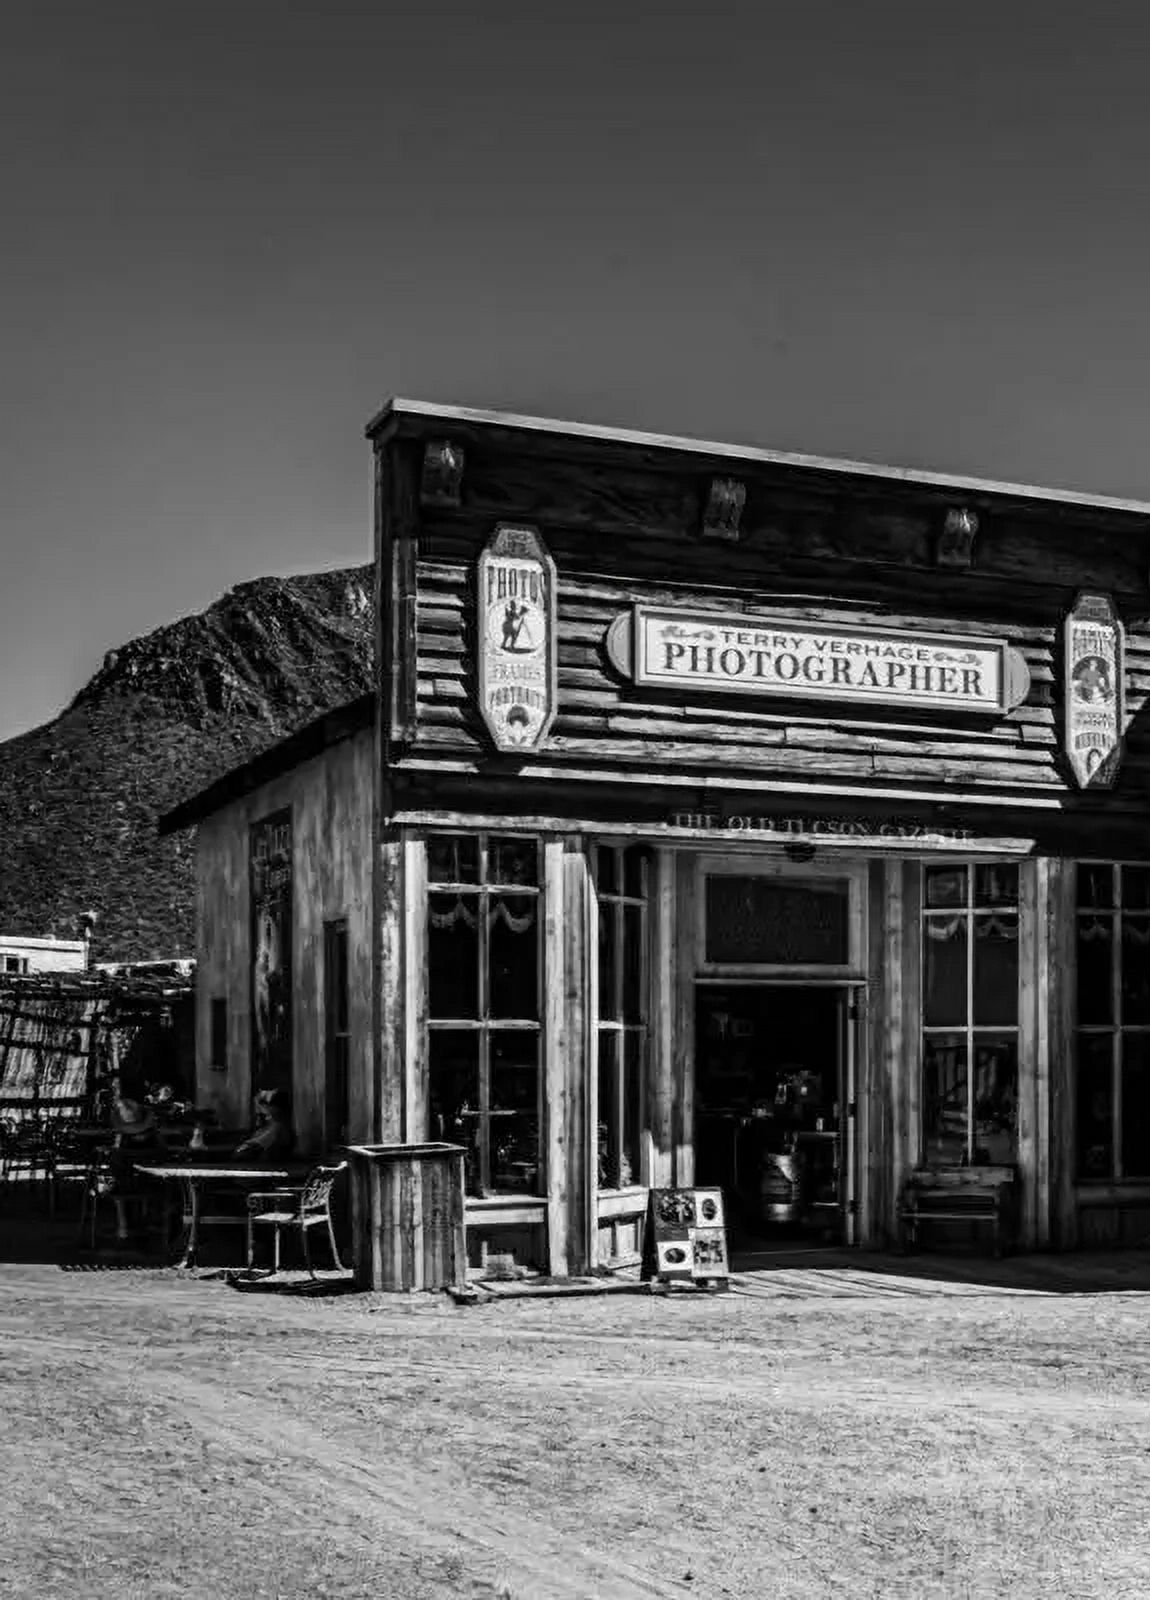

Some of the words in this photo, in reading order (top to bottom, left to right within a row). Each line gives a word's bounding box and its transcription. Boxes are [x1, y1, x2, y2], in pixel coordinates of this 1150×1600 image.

[487, 565, 544, 605] PHOTO
[719, 630, 803, 652] TERRY
[812, 638, 930, 662] VERHAGE
[663, 641, 983, 697] PHOTOGRAPHER
